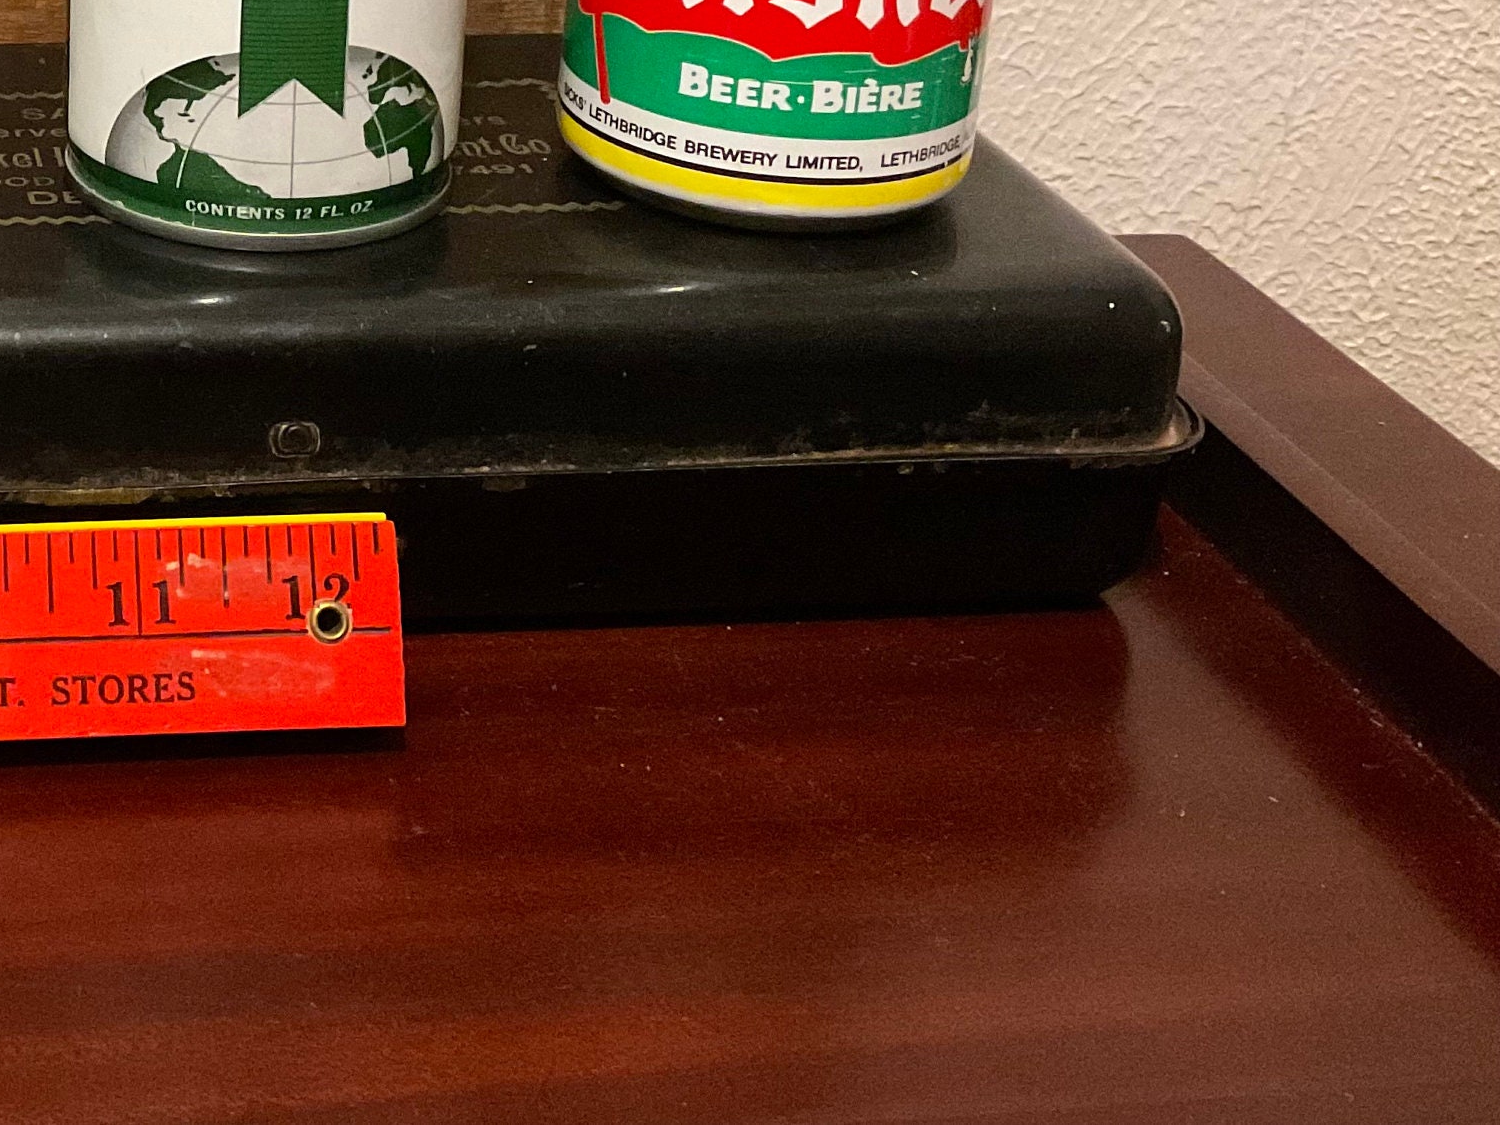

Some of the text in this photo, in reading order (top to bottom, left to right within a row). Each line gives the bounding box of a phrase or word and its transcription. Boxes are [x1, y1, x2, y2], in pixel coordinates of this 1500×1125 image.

[589, 103, 677, 151] LETHBRIDGE
[685, 140, 777, 168] BREWERY
[786, 154, 863, 173] LIMITED,
[186, 200, 285, 220] CONTENTS
[295, 208, 313, 219] 12
[107, 579, 177, 628] 11
[50, 671, 196, 707] STORES
